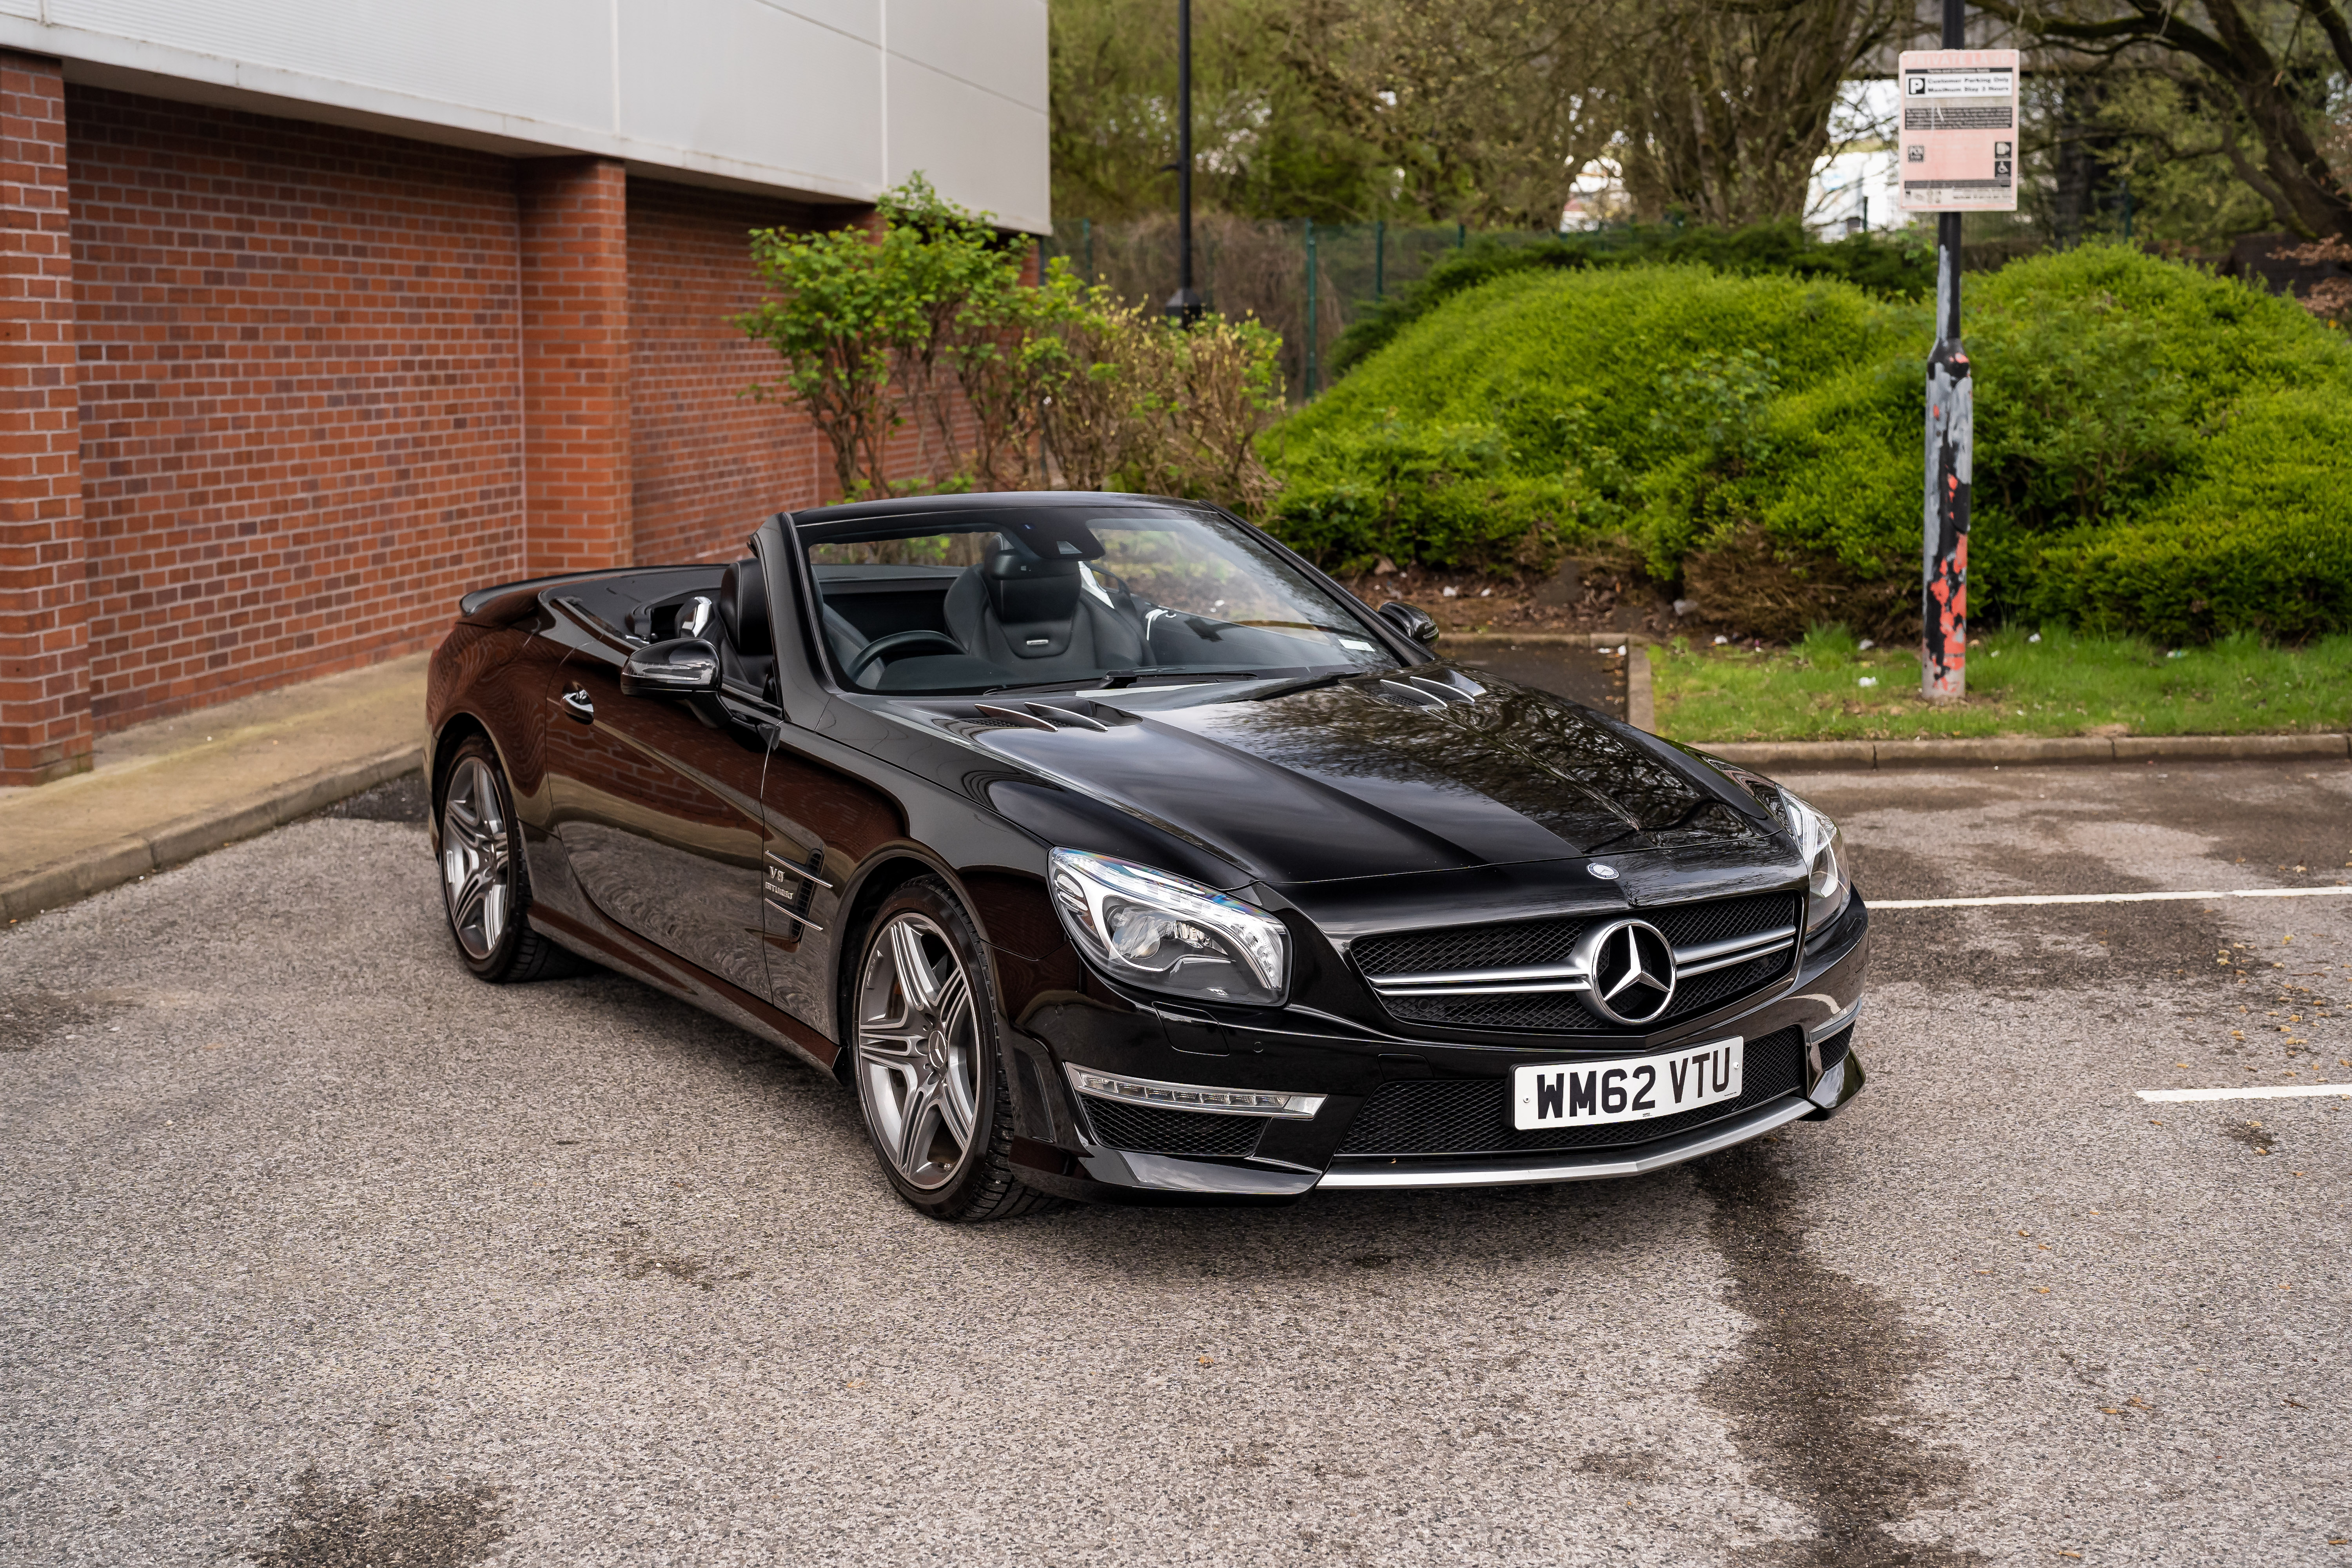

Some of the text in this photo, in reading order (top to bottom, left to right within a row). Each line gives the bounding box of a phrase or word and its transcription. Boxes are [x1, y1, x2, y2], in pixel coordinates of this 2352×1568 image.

[1907, 53, 2009, 65] PRIVATE LAND
[769, 866, 785, 882] V8
[1536, 1047, 1730, 1120] WM62 VTU
